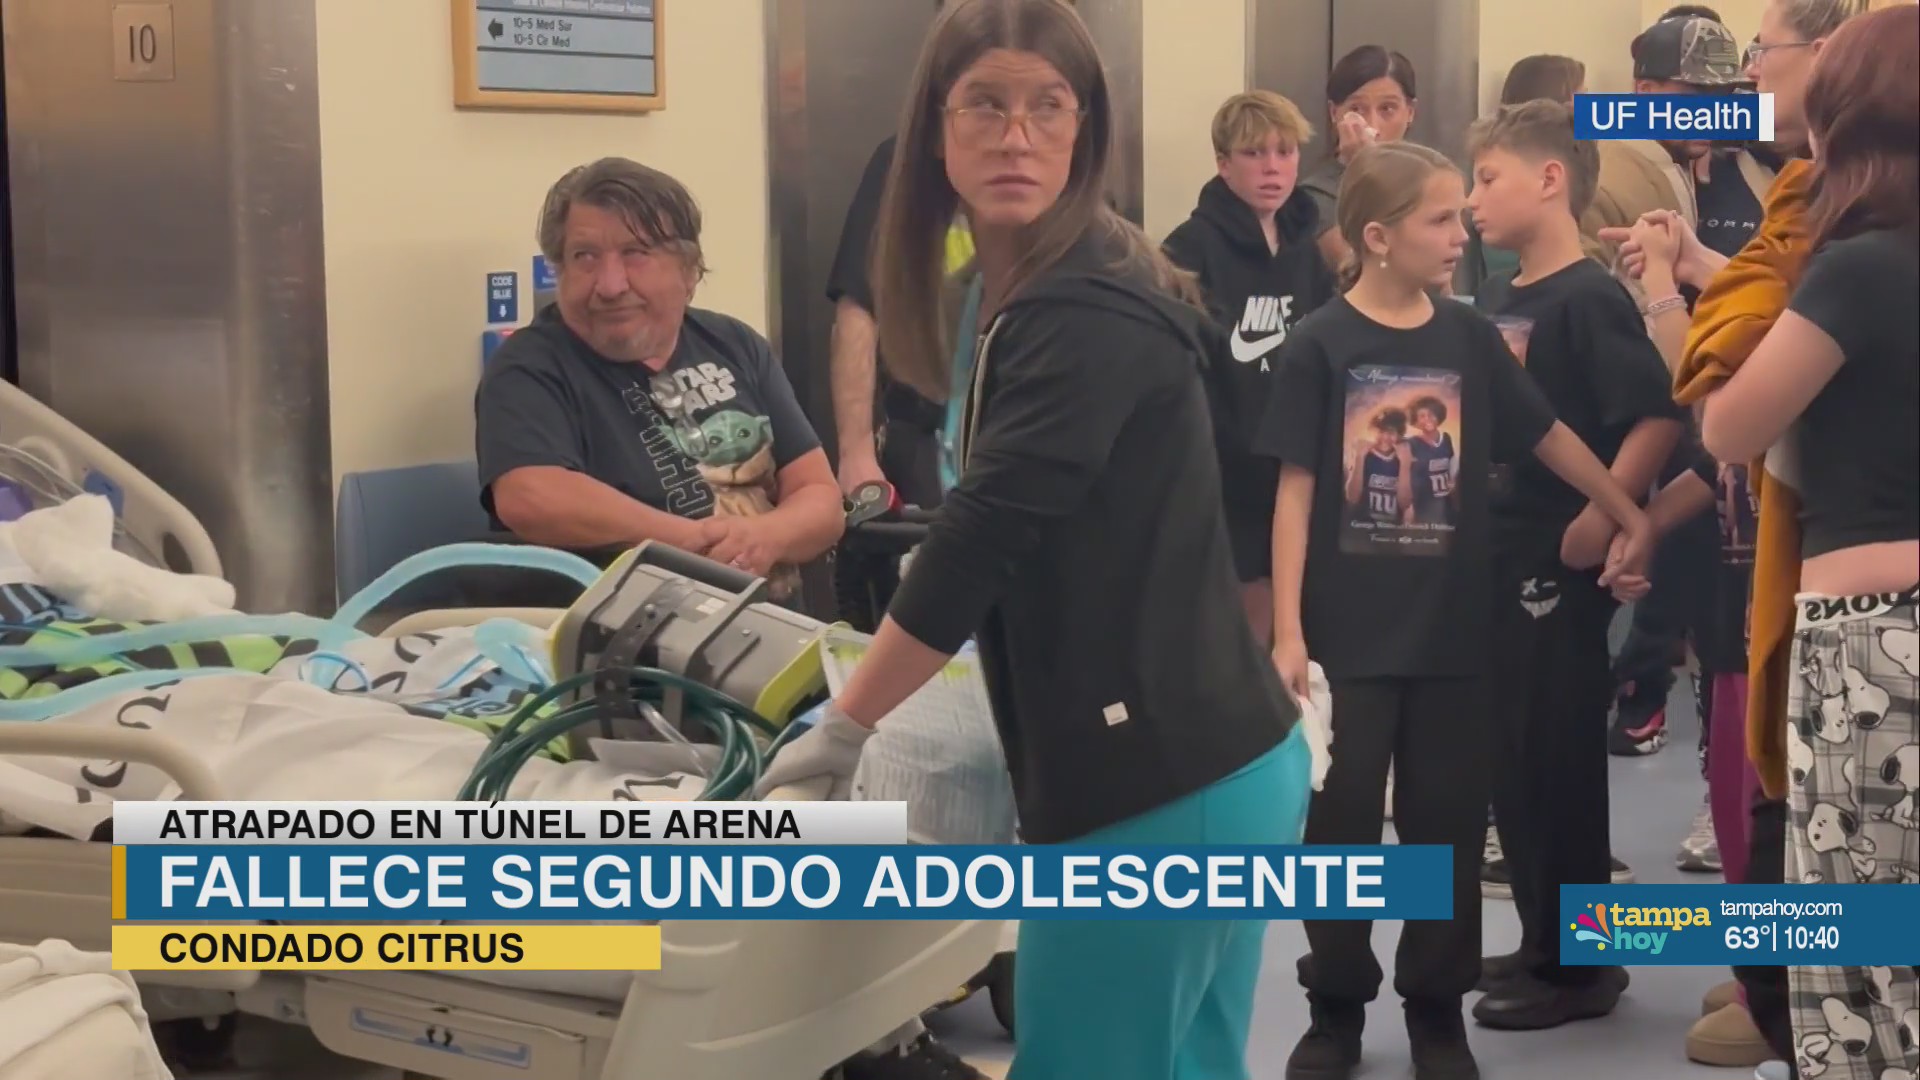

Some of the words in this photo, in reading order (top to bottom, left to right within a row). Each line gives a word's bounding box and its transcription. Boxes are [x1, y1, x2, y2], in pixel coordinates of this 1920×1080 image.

[537, 18, 555, 31] Med
[129, 24, 157, 63] 10
[552, 36, 571, 47] Med
[491, 275, 513, 287] CODE
[493, 288, 512, 300] BLUE
